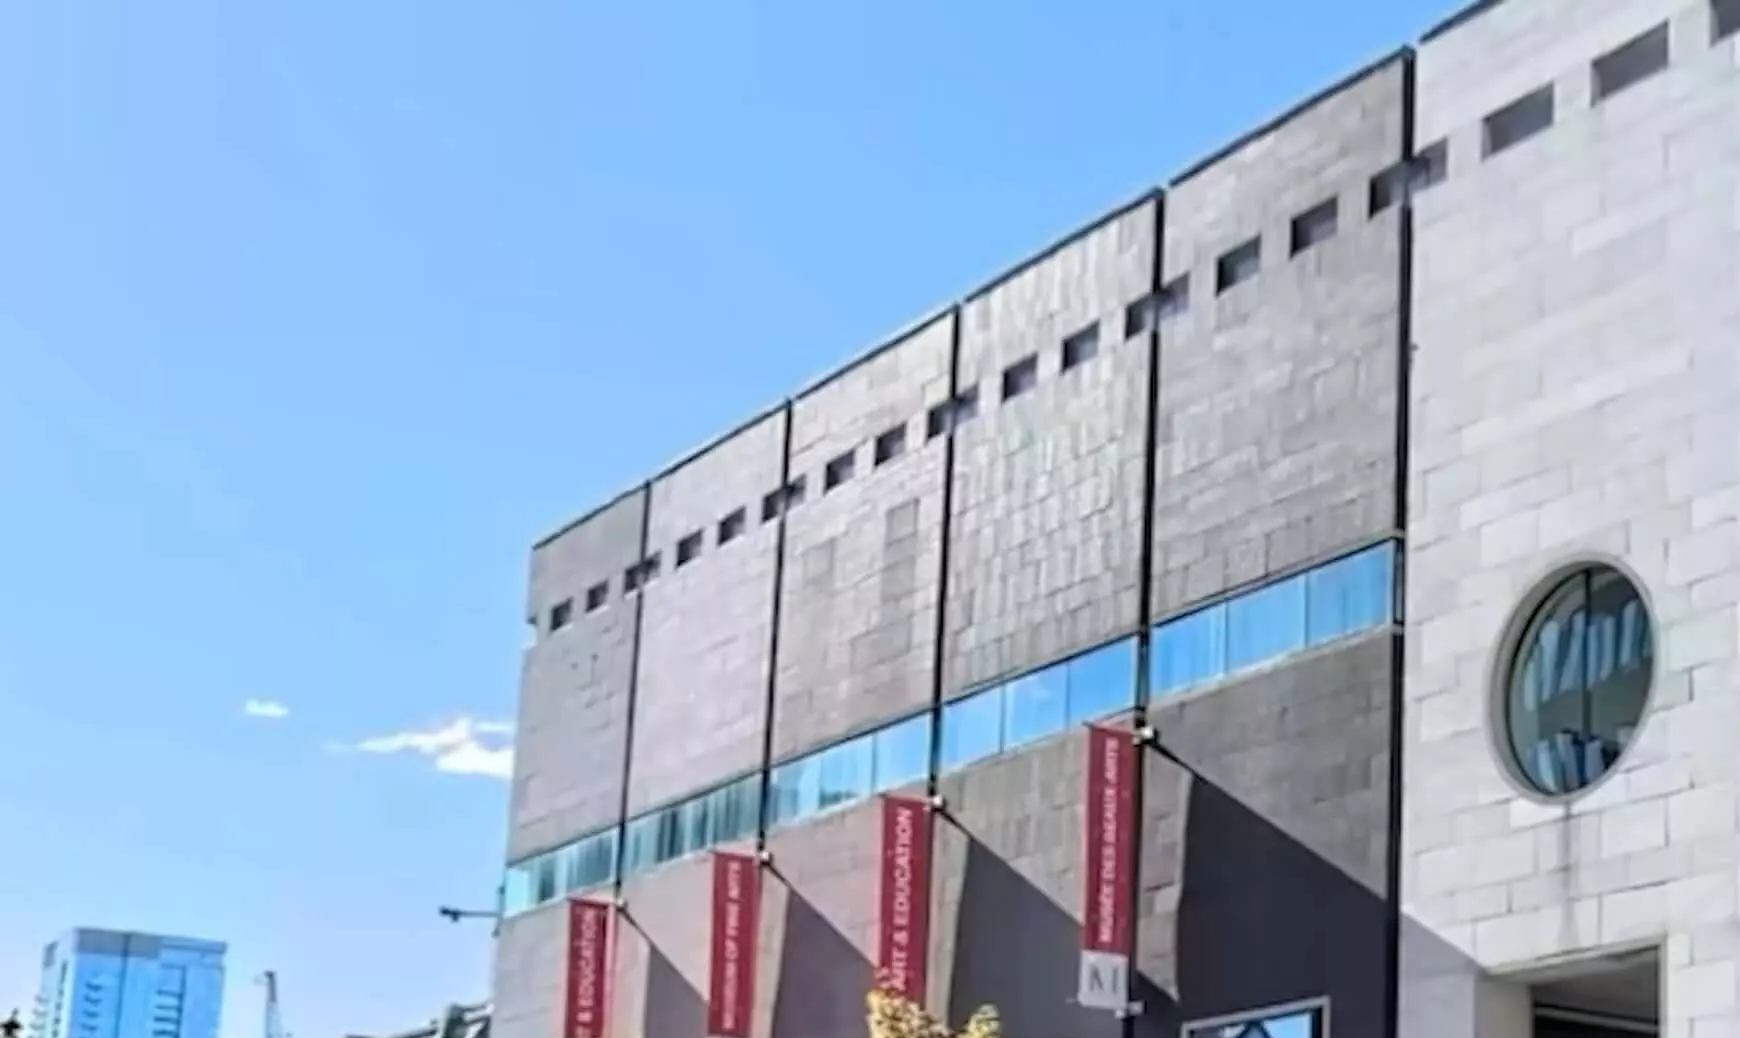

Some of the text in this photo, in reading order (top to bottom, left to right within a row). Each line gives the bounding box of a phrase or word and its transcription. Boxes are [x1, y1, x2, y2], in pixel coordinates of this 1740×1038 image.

[893, 807, 912, 927] EDUCATION
[578, 909, 597, 1006] EDUCATION
[892, 929, 908, 946] &
